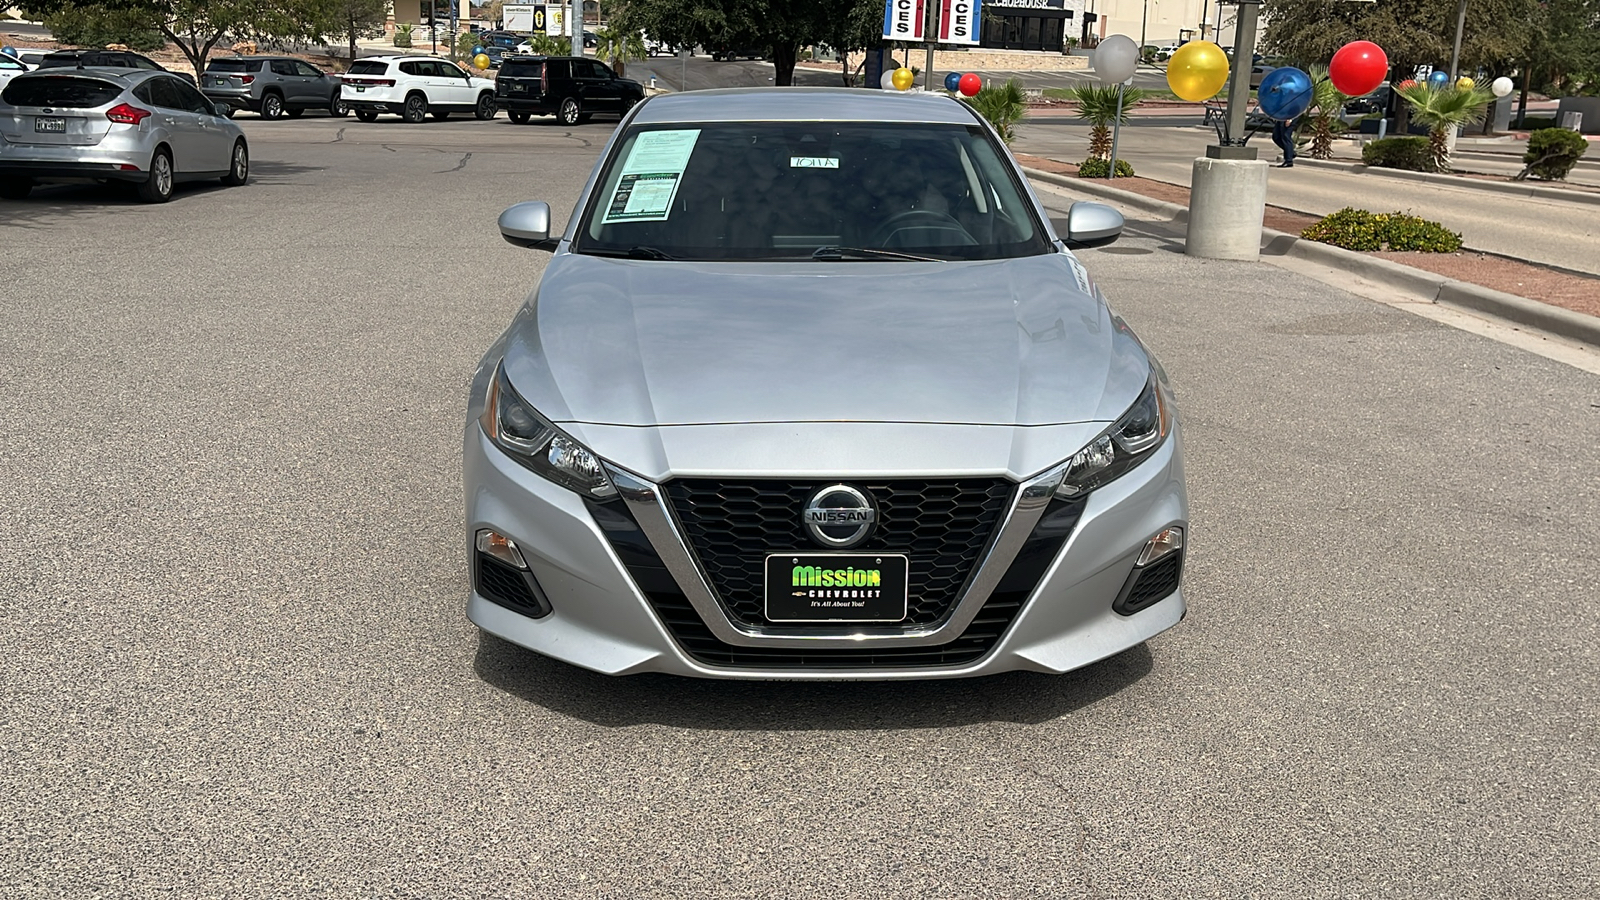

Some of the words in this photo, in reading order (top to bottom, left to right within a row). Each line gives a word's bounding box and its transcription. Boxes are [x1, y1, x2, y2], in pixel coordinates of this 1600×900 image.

[812, 512, 867, 521] NISSAN
[792, 565, 881, 587] Mission
[809, 590, 881, 598] CHEVROLET
